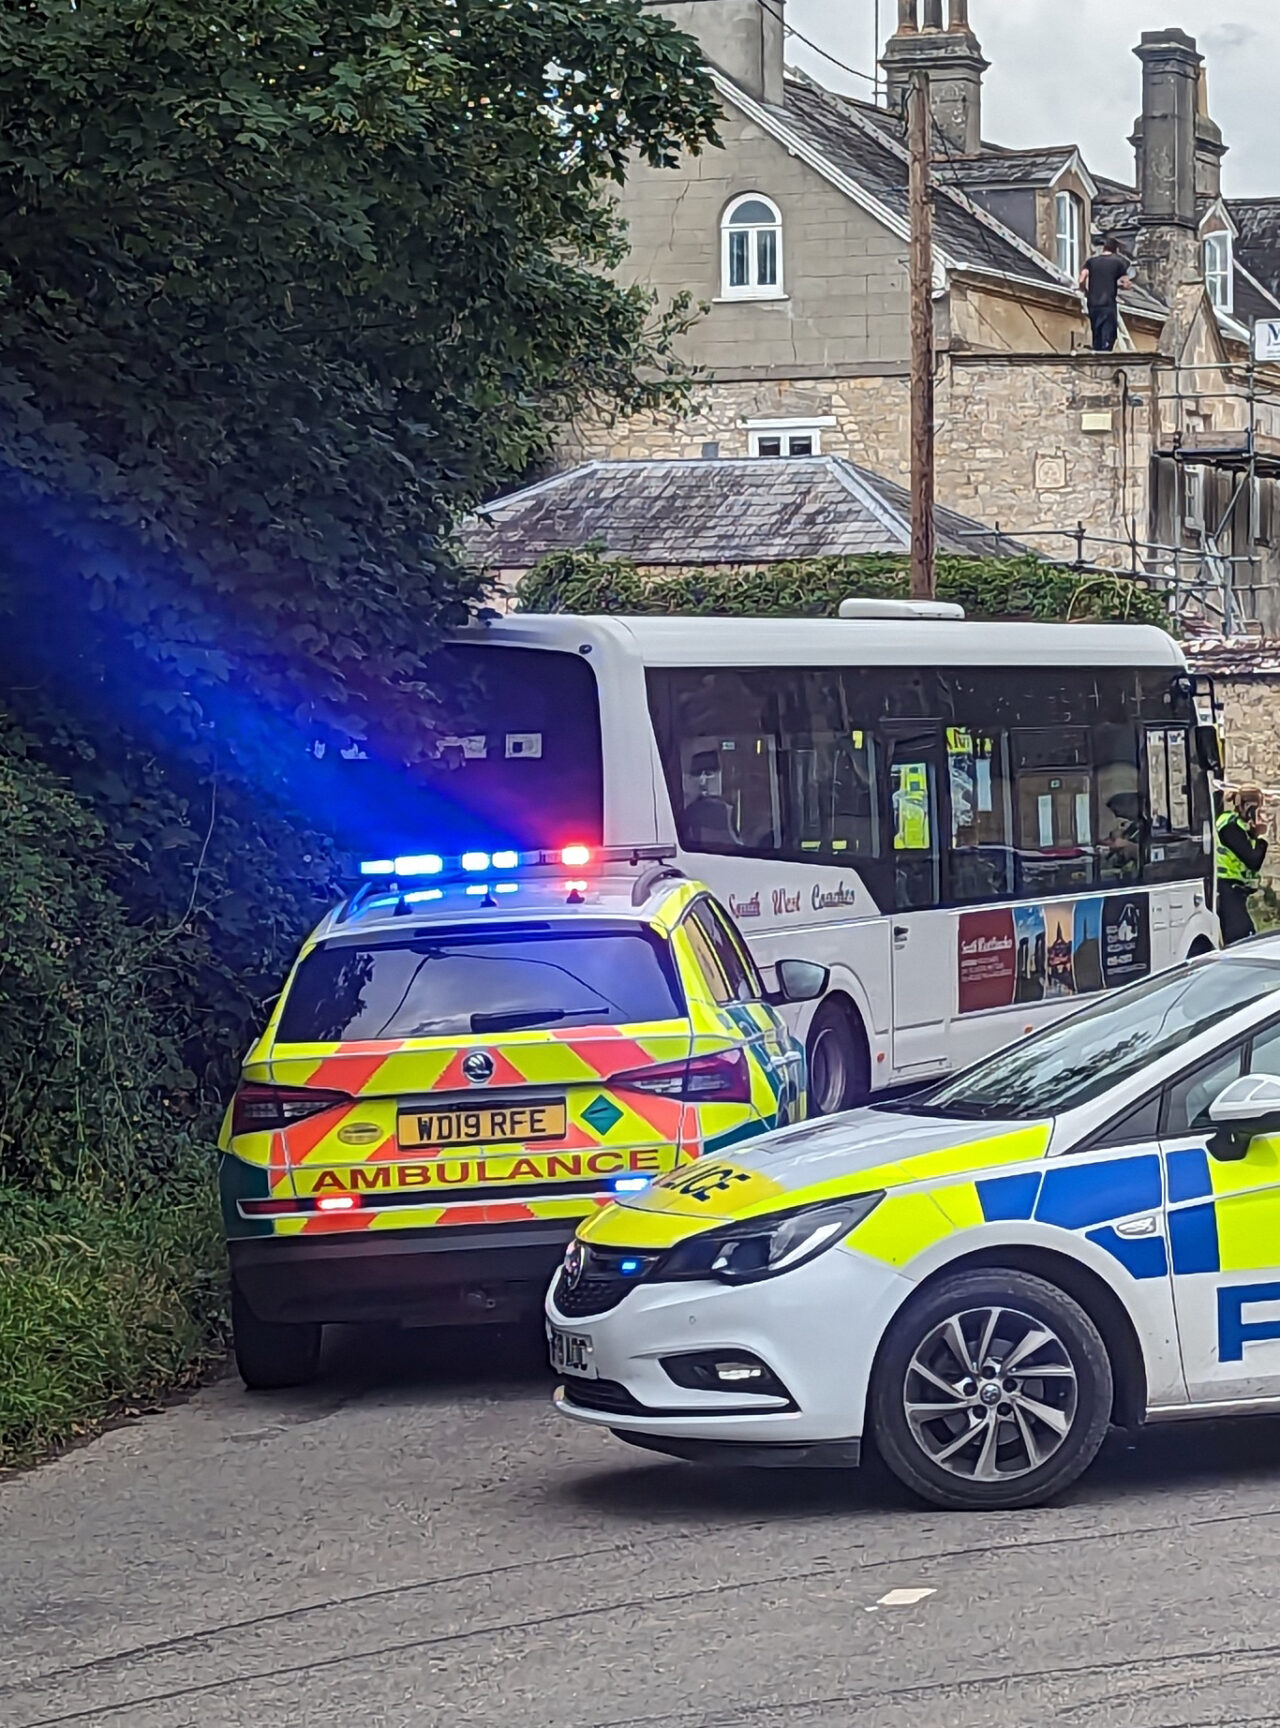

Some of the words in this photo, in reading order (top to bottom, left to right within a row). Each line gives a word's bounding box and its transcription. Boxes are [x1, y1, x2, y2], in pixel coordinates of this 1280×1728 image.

[417, 1113, 481, 1142] WD19
[490, 1108, 547, 1137] RFE
[311, 1149, 661, 1193] AMBULANCE
